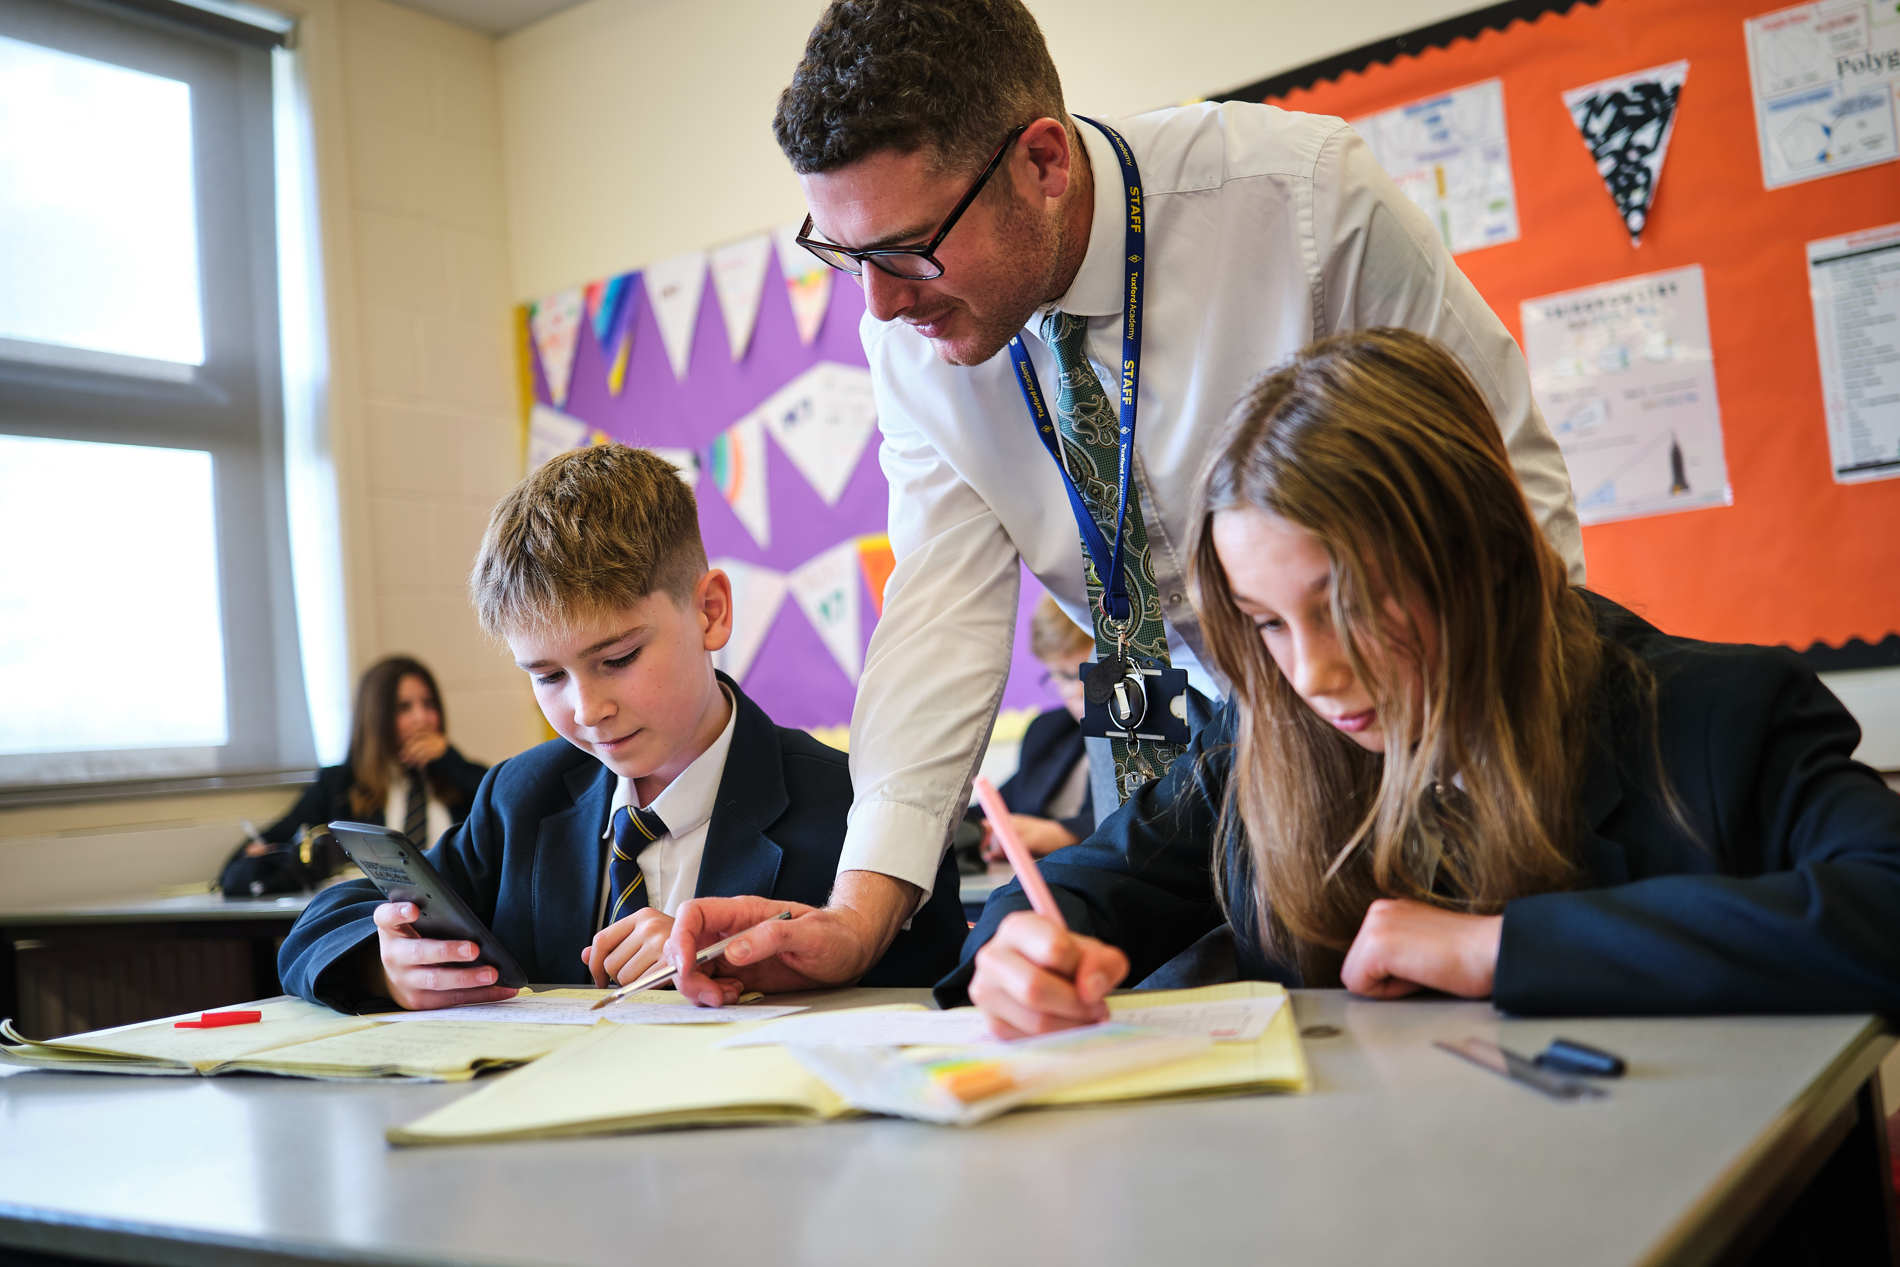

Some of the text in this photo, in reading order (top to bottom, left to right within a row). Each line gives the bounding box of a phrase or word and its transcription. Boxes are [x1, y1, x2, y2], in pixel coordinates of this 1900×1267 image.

[1113, 136, 1133, 166] Academy
[1130, 186, 1141, 233] STAFF
[1127, 272, 1139, 340] Tuxford Academy
[1020, 361, 1045, 418] Tuxford Academy
[1122, 360, 1135, 405] STAFF
